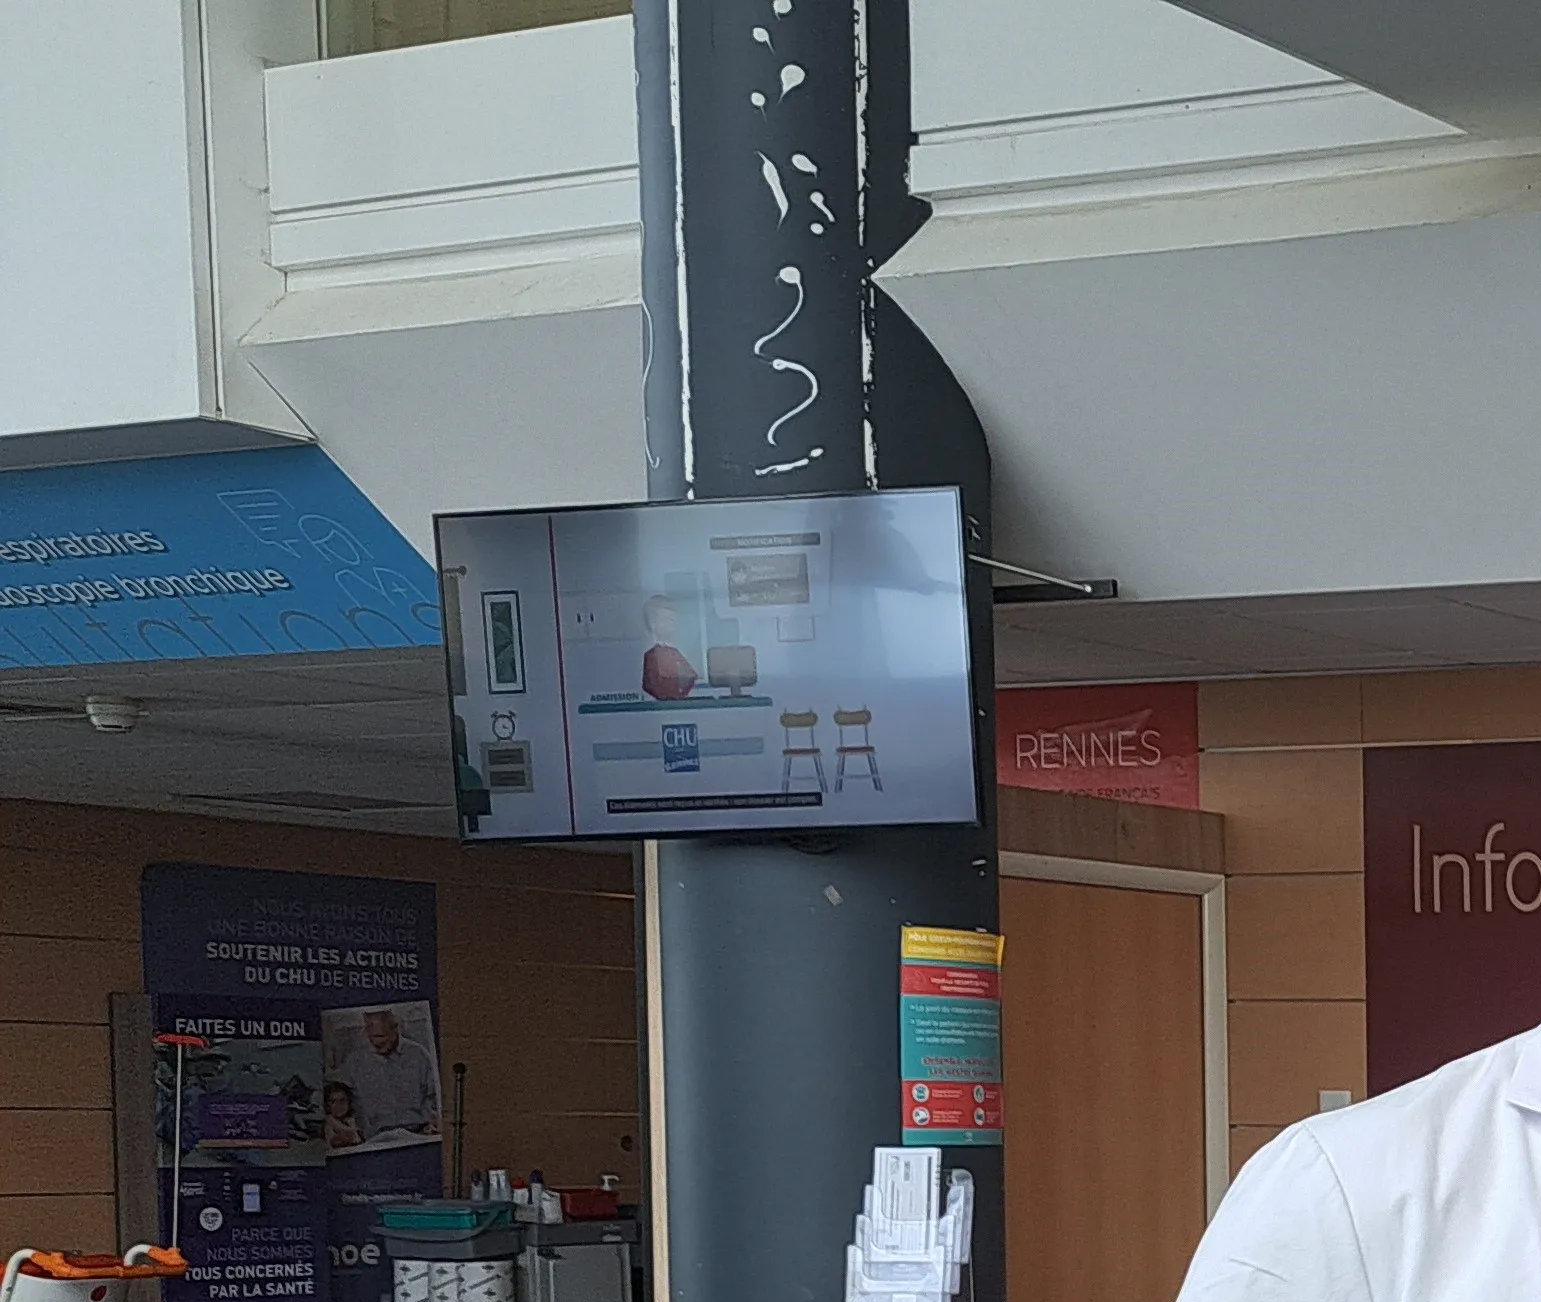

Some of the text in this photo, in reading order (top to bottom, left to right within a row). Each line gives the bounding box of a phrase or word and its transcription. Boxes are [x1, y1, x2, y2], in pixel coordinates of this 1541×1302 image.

[111, 565, 289, 597] bronchique
[664, 727, 697, 748] CHU
[1016, 730, 1161, 769] RENNES
[206, 941, 419, 970] SOUTENIR LES ACTIONS
[244, 966, 419, 991] DU CHU DE RENNES
[175, 1017, 306, 1037] FAITES UN DON
[231, 1226, 280, 1242] PARCE
[225, 1259, 314, 1280] CONCERNÉS
[209, 1278, 315, 1299] PAR LA SANTÉ
